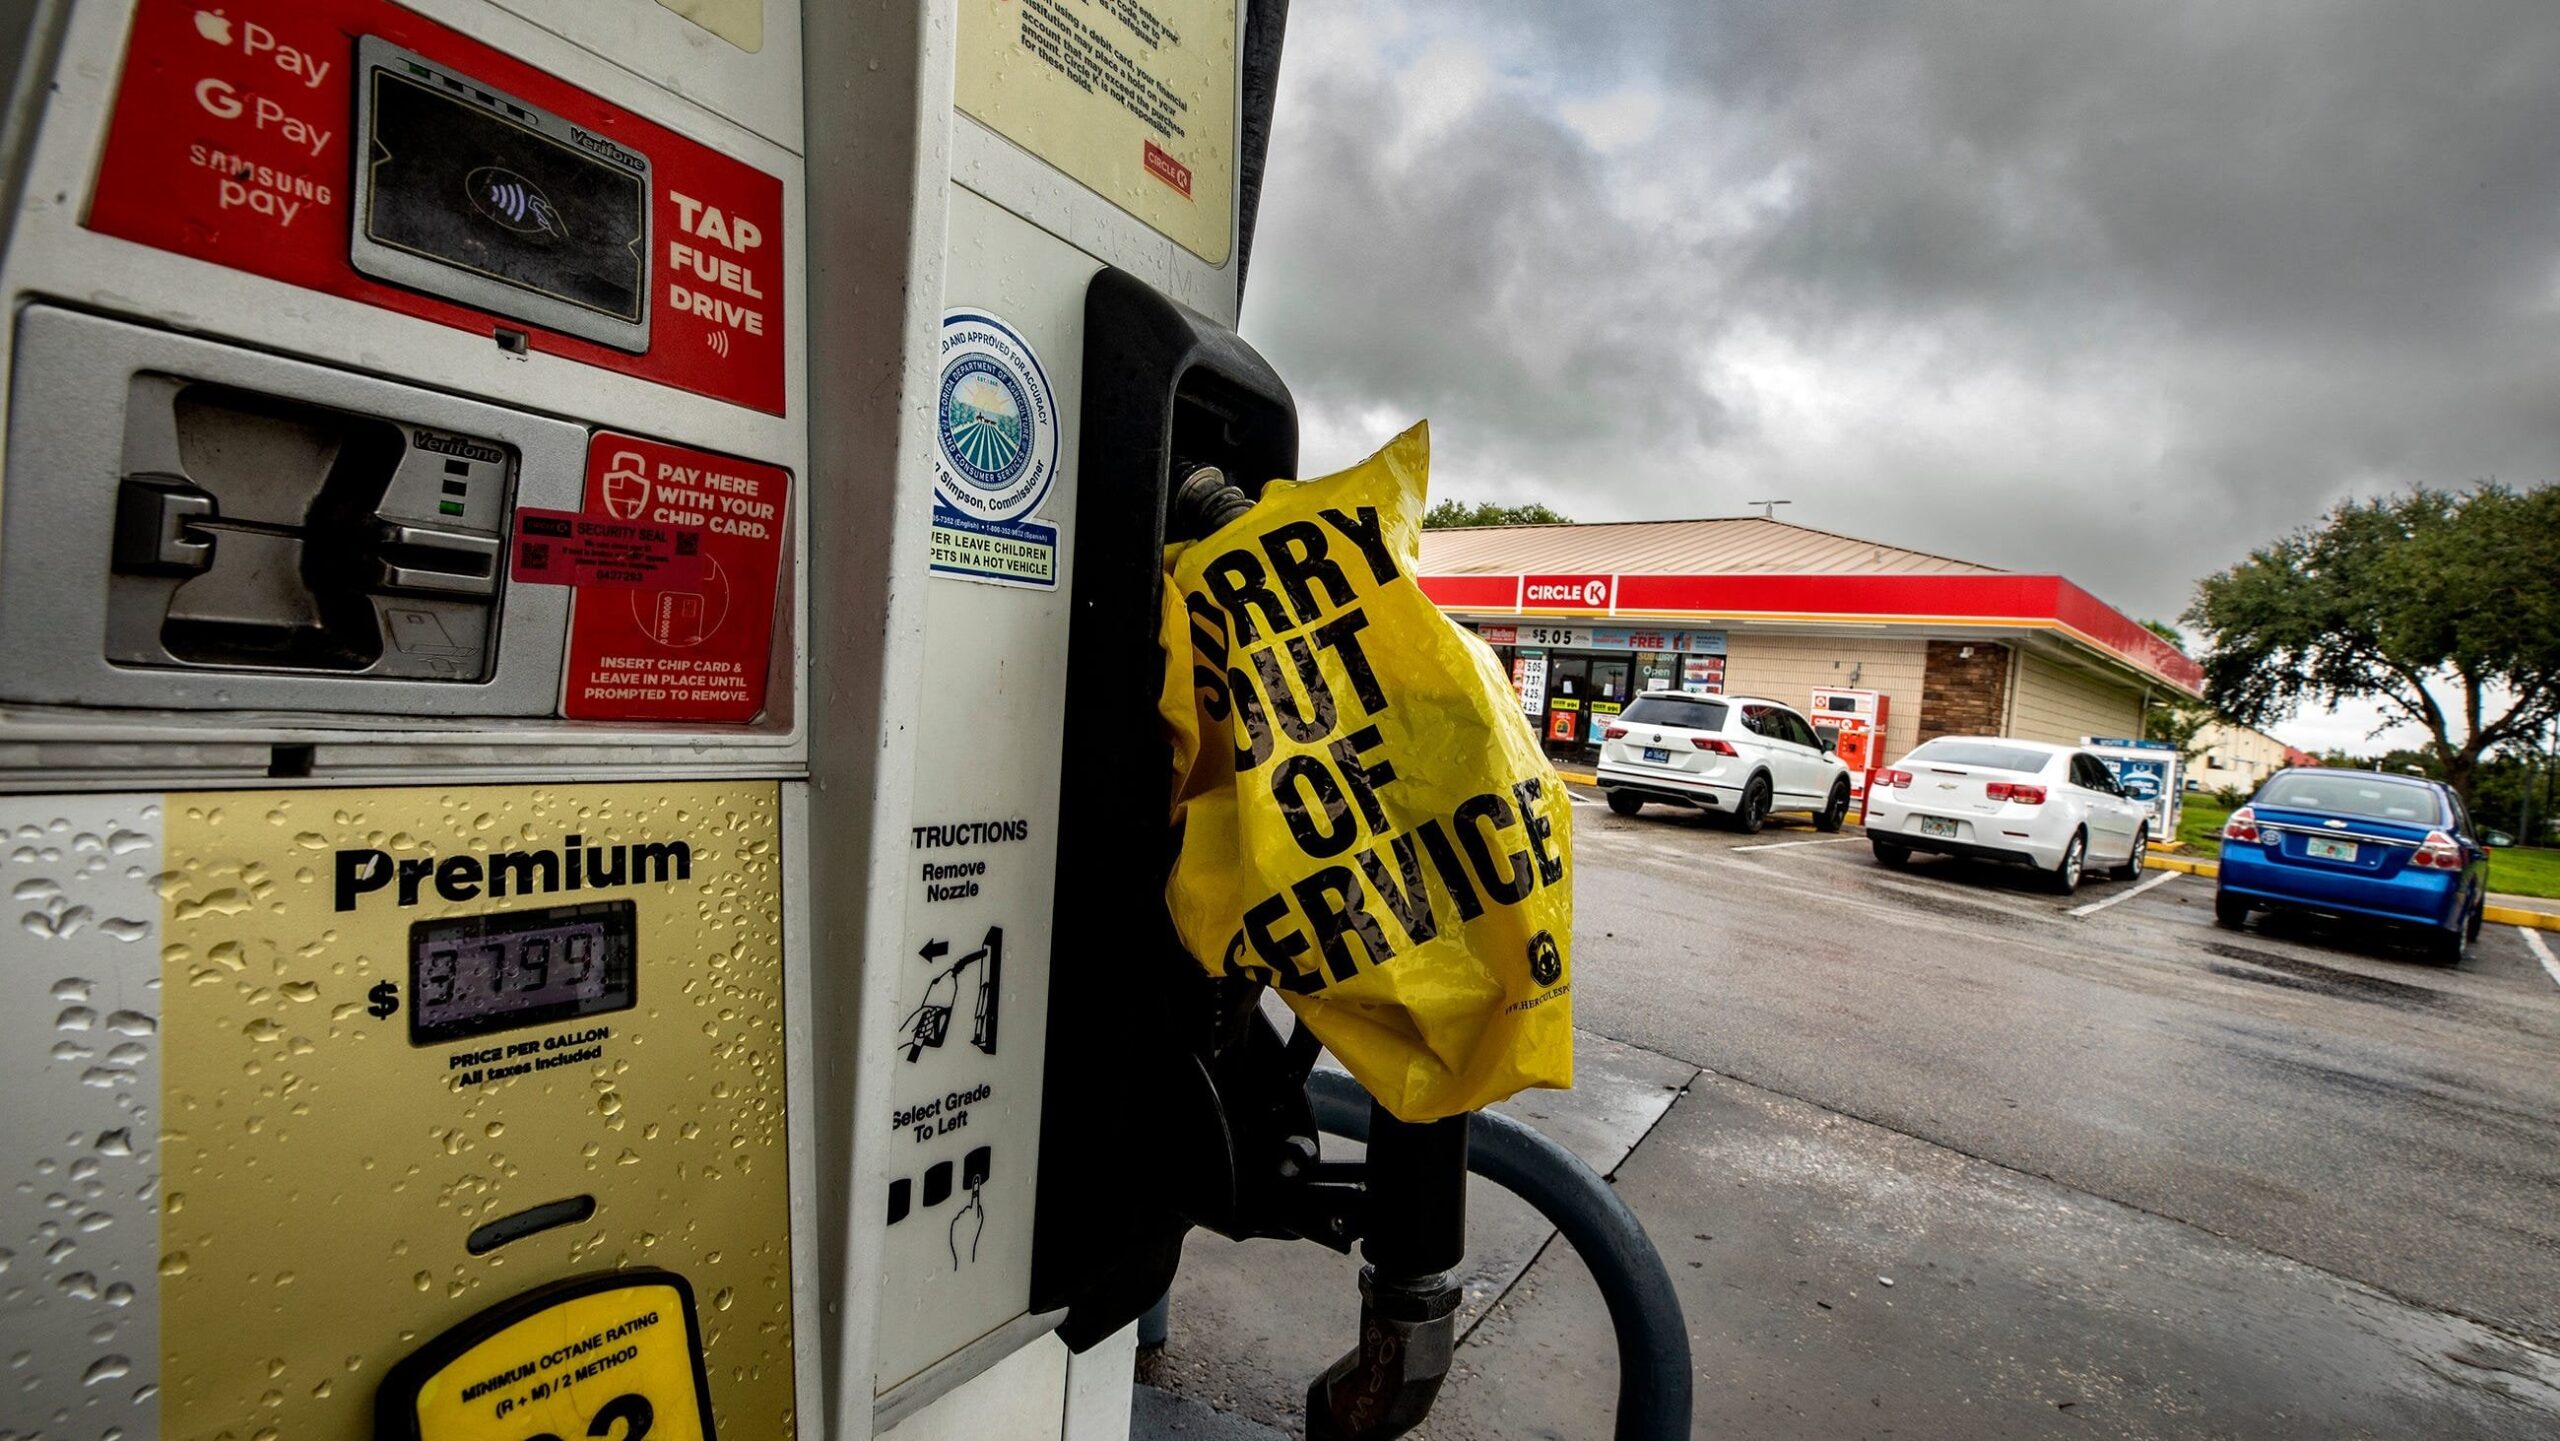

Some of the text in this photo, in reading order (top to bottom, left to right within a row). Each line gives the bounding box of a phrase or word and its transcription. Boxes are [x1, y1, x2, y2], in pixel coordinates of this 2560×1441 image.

[1111, 6, 1116, 16] a
[1118, 12, 1158, 50] safeguard
[1140, 6, 1160, 27] enter
[1162, 24, 1178, 44] your
[1141, 20, 1150, 31] or
[1152, 27, 1160, 40] to
[243, 21, 330, 88] Pay
[1021, 34, 1094, 95] for these holds.
[1022, 10, 1184, 138] account that may exceed the purchase
[1054, 2, 1187, 112] using a debit card, your financial
[1074, 34, 1092, 54] may
[1095, 50, 1118, 72] place
[1120, 69, 1126, 78] a
[1128, 72, 1145, 94] hold
[1147, 90, 1157, 102] on
[1158, 98, 1176, 116] your
[1022, 23, 1171, 139] amount. Circle K is not responsible
[195, 78, 331, 157] G Pay
[571, 127, 645, 172] Verifone
[1148, 152, 1176, 178] CIRCLE
[190, 144, 331, 205] SAMSUNG
[219, 179, 299, 227] pay
[670, 190, 762, 253] TAP
[670, 240, 763, 300] FUEL
[670, 284, 763, 336] DRIVE
[940, 361, 1030, 440] FLORIDA DEPARTMENT OF AGRICULTURE
[950, 332, 966, 347] AND
[967, 331, 1010, 356] APPROVED
[1010, 351, 1026, 372] FOR
[1023, 371, 1048, 426] ACCURACY
[413, 430, 503, 464] Verifone
[944, 432, 1025, 482] AND CONSUMER SERVICES
[658, 463, 759, 497] PAY HERE
[940, 470, 986, 512] Simpson,
[988, 459, 1045, 511] Commissioner
[653, 507, 770, 540] CHIP CARD.
[656, 485, 775, 520] WITH YOUR
[577, 522, 636, 539] SECURITY
[638, 529, 668, 543] SEAL
[955, 536, 990, 552] LEAVE
[994, 542, 1046, 560] CHILDREN
[960, 552, 970, 564] IN
[972, 554, 980, 566] A
[983, 556, 1004, 569] HOT
[1006, 560, 1048, 576] VEHICLE
[1527, 583, 1605, 604] CIRCLE K
[600, 656, 742, 672] INSERT CHIP CARD &
[1629, 636, 1664, 648] FREE
[1638, 652, 1678, 662] SUBWAY
[591, 672, 747, 687] LEAVE IN PLACE UNTIL
[1227, 608, 1388, 772] OUT
[1643, 665, 1670, 677] Open
[584, 688, 750, 702] PROMPTED TO REMOVE.
[1270, 724, 1398, 859] OF
[912, 820, 1028, 849] TRUCTIONS
[335, 834, 691, 912] Premium
[922, 861, 986, 882] Remove
[927, 881, 979, 902] Nozzle
[1223, 777, 1563, 996] SERVICE
[368, 979, 399, 1021] $
[449, 1026, 609, 1070] PRICE PER GALLON
[459, 1070, 483, 1088] All
[487, 1062, 532, 1081] taxes
[892, 1084, 991, 1131] Select Grade
[914, 1110, 968, 1144] To Left
[462, 1312, 659, 1403] MINIMUM OCTANE RATING
[496, 1398, 514, 1420] (R
[518, 1396, 528, 1406] +
[531, 1382, 550, 1401] M)
[562, 1374, 572, 1388] 2
[575, 1346, 638, 1382] METHOD
